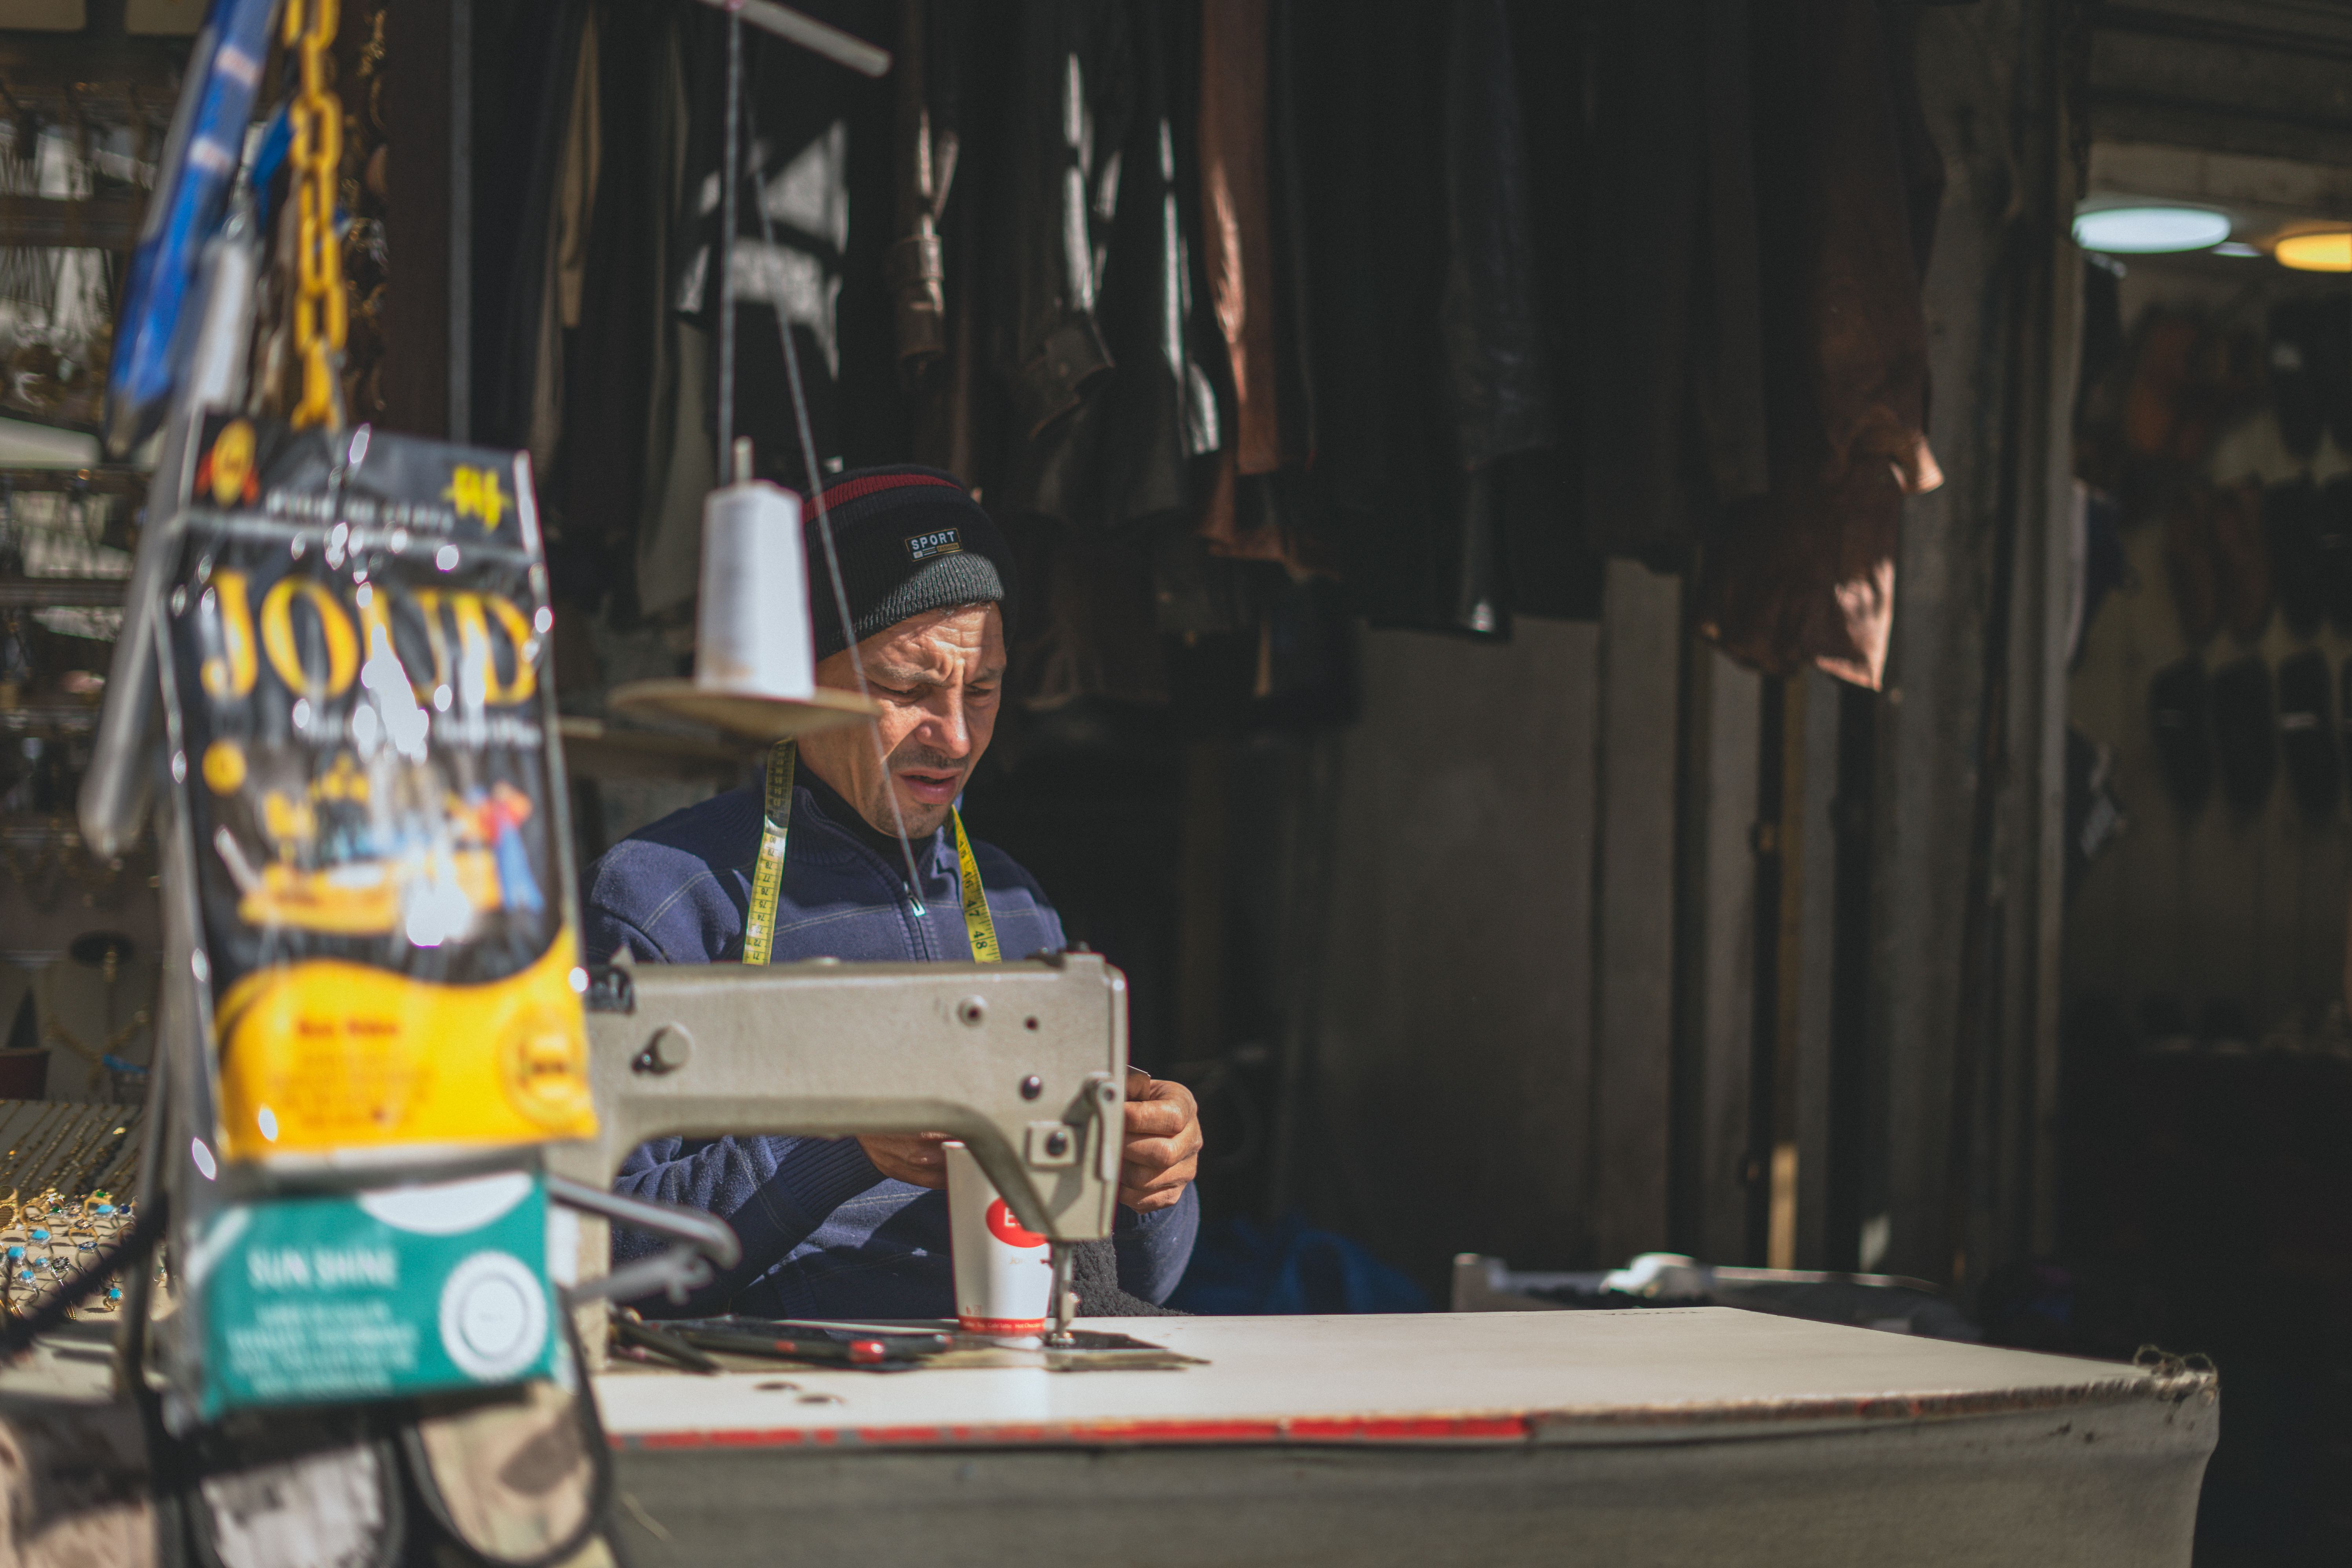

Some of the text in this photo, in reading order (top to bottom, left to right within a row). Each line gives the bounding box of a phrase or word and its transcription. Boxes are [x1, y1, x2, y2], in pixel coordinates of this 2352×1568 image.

[911, 531, 954, 550] SPORT
[964, 871, 973, 889] 46
[967, 900, 980, 916] 47
[974, 931, 987, 949] 48
